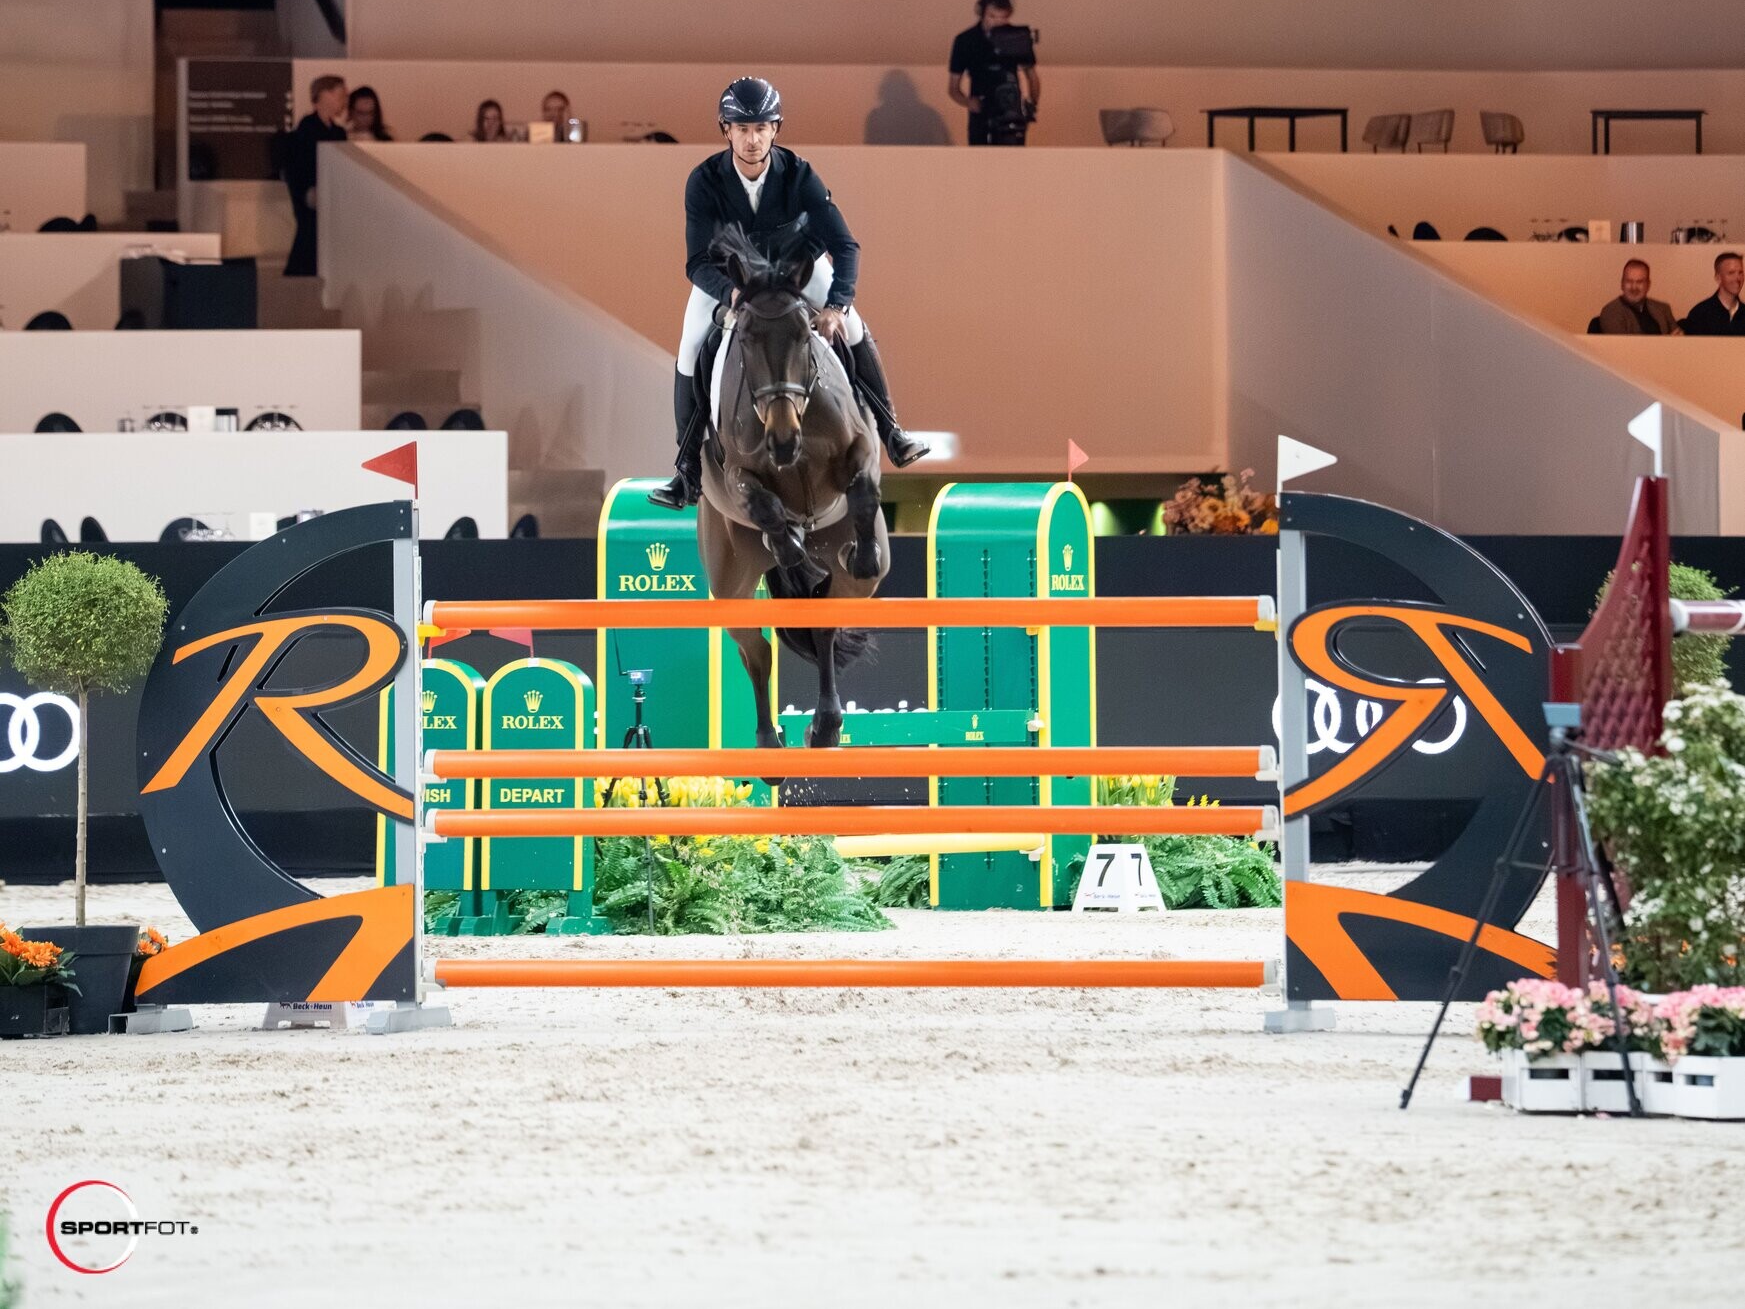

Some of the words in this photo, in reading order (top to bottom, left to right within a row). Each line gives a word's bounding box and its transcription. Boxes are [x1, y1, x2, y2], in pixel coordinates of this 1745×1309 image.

[619, 574, 696, 592] ROLEX
[1051, 574, 1085, 591] ROLEX
[422, 715, 457, 730] LEX
[501, 715, 564, 730] ROLEX
[422, 788, 451, 803] ISH
[500, 789, 565, 803] DEPART
[1096, 853, 1115, 887] 7
